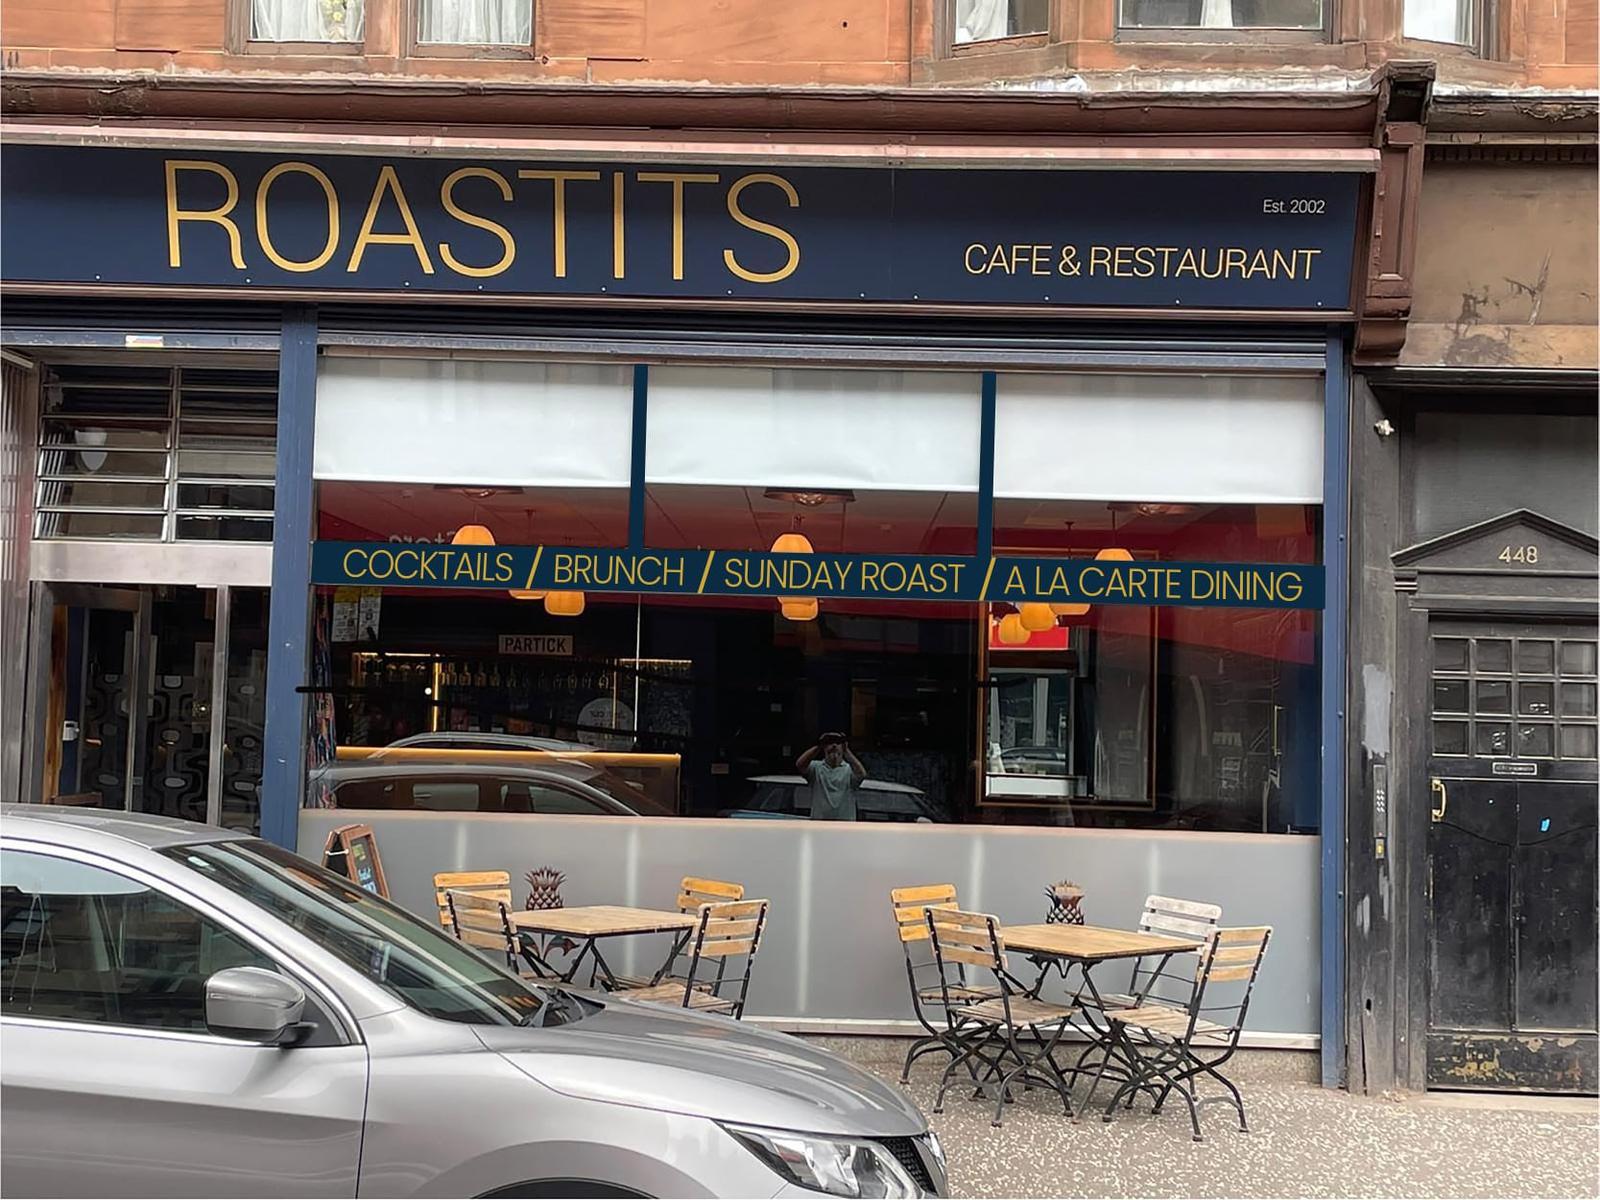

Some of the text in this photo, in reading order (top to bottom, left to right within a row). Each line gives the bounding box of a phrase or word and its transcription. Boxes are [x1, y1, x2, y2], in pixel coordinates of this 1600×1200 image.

[1290, 199, 1326, 214] 2002
[164, 159, 802, 283] ROASTITS
[964, 243, 1322, 280] CAFE & RESTAURANT
[1498, 545, 1538, 564] 448
[343, 549, 513, 585] COCKTAILS
[553, 553, 685, 586] BRUNCH
[724, 559, 853, 594] SUNDAY
[861, 562, 966, 594] ROAST
[1003, 566, 1027, 596] A
[1034, 567, 1072, 598] LA
[1079, 567, 1184, 600] CARTE
[1191, 570, 1304, 604] DINING
[504, 637, 567, 653] PARTICK
